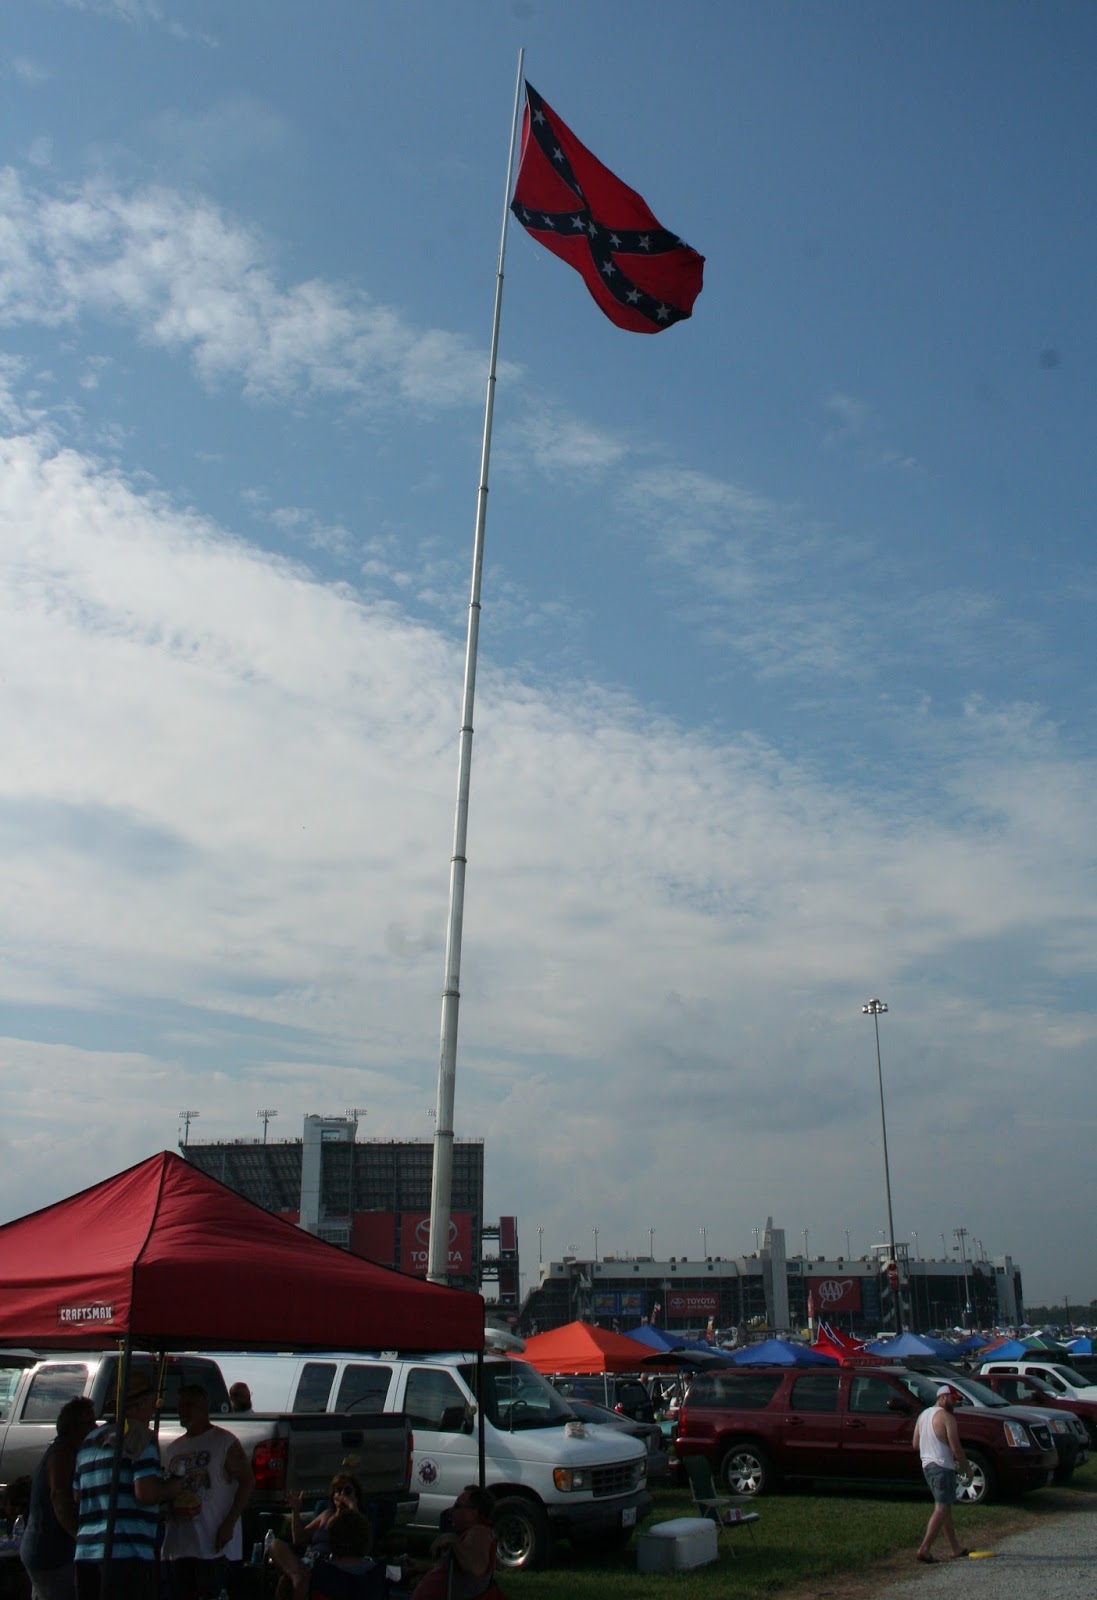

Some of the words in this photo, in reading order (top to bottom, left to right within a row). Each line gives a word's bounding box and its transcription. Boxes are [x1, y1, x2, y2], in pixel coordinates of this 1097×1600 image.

[410, 1251, 463, 1261] TOTA
[820, 1280, 843, 1301] AAA
[60, 1307, 112, 1320] CRAFTSMAN
